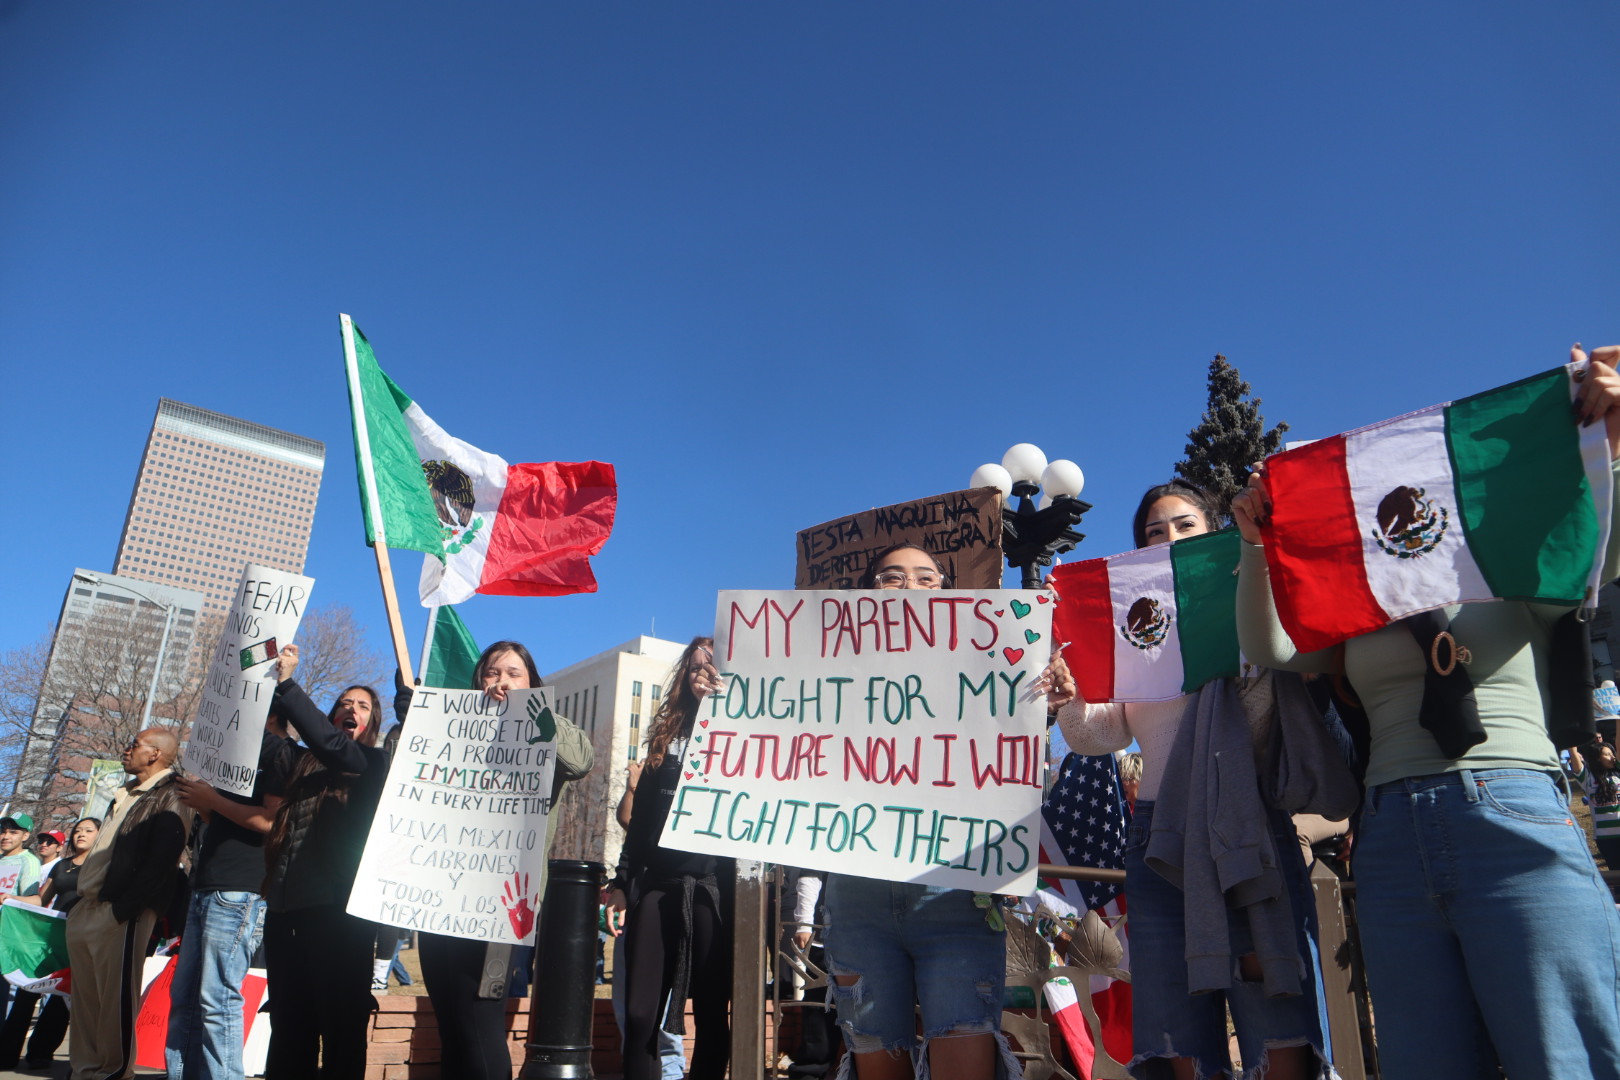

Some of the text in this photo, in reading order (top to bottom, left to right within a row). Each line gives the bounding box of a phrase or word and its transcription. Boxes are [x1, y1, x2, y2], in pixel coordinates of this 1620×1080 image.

[242, 580, 305, 617] FEAR
[727, 597, 999, 661] MY PARENTS
[240, 680, 263, 702] IT
[413, 691, 509, 716] I WOULD
[708, 670, 1027, 724] FOUGHT FOR MY
[196, 722, 224, 748] WORLD
[226, 709, 240, 731] A
[447, 718, 534, 742] CHOOSE TO
[409, 735, 552, 767] BE A PRODUCT OF
[699, 730, 1042, 789] FUTURE NOW I WILL
[414, 762, 541, 792] IMMIGRANTS
[397, 783, 423, 802] IN
[431, 790, 483, 810] EVERY
[389, 814, 537, 851] VIVA MEXICO
[671, 786, 1030, 877] FIGHT FOR THEIRS
[409, 844, 517, 875] CABRONES
[377, 877, 498, 914] TODOS LOS
[449, 872, 463, 890] Y
